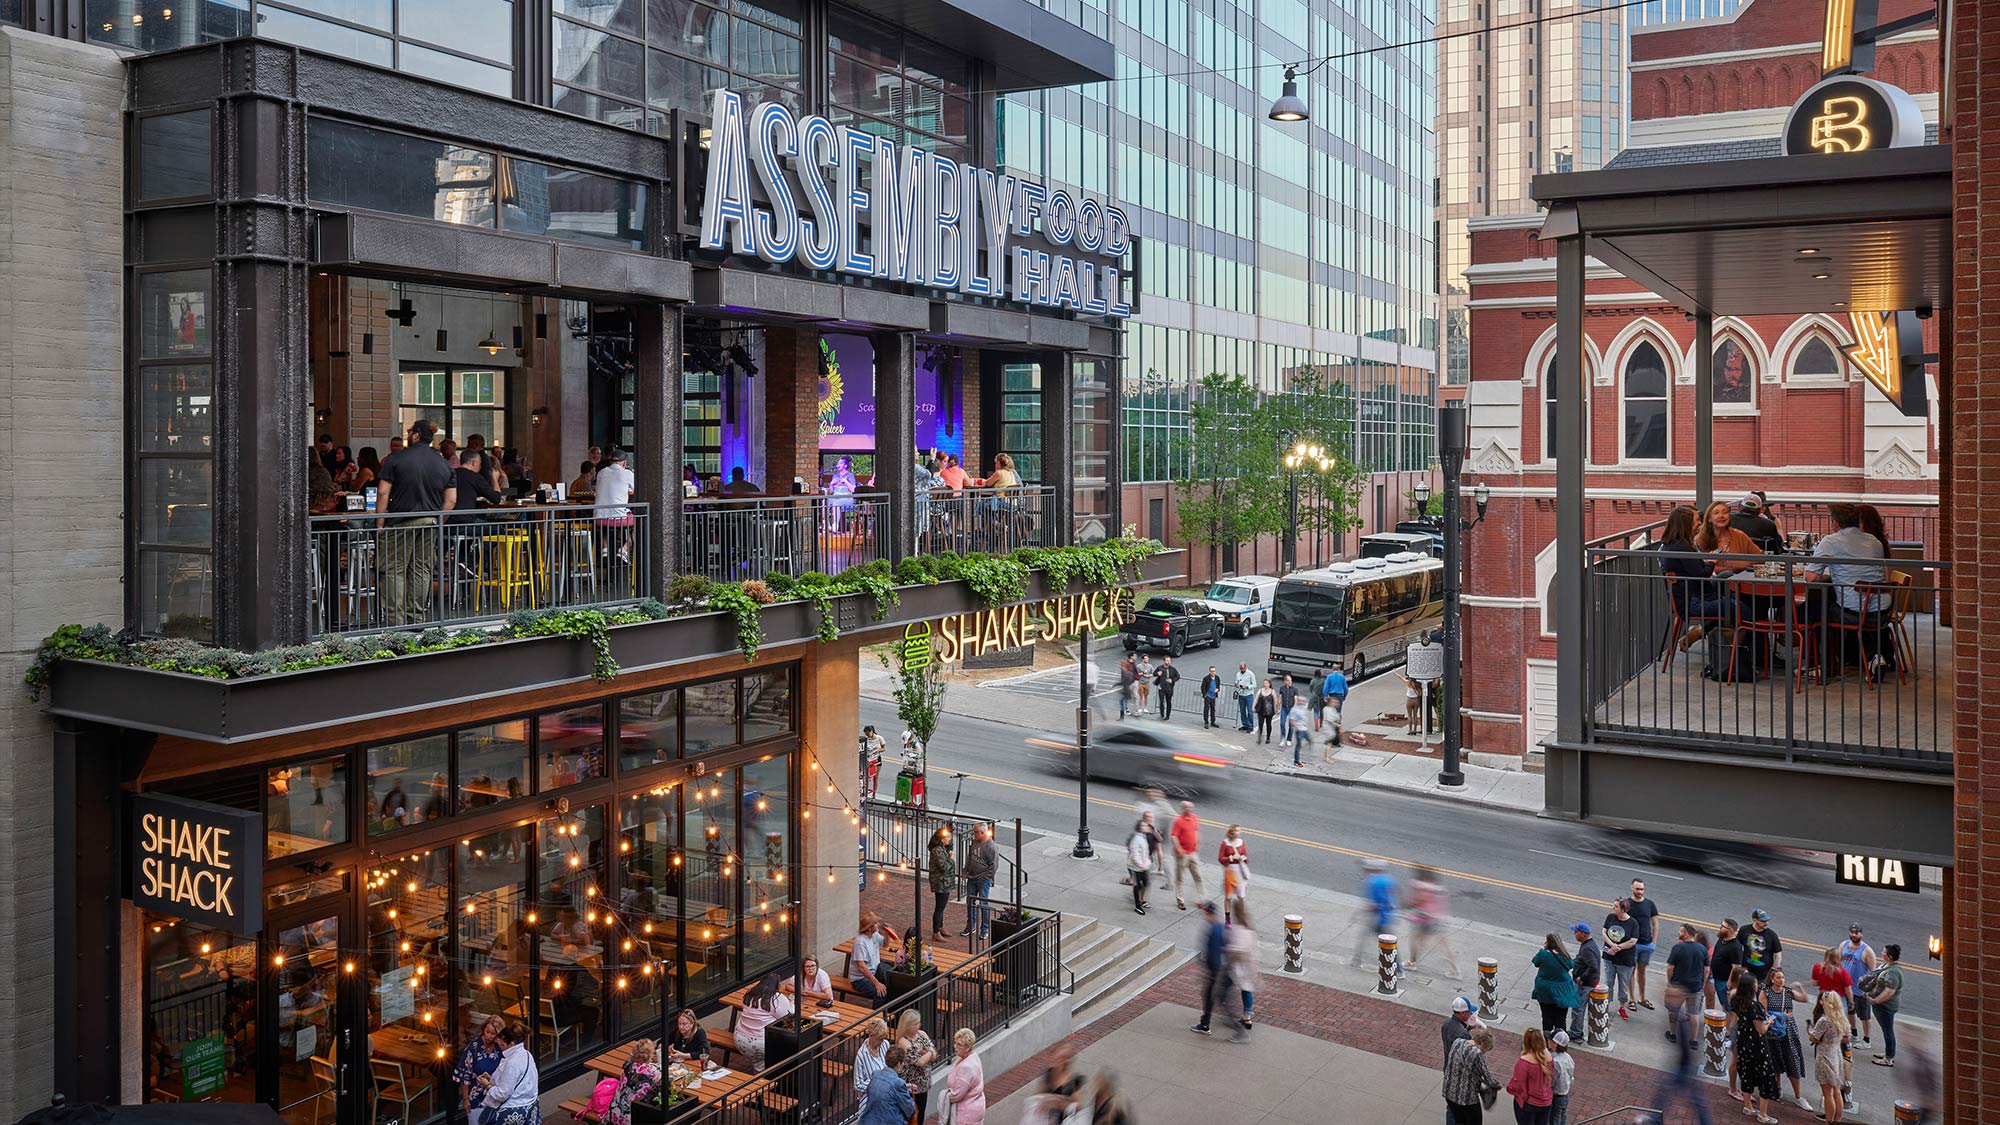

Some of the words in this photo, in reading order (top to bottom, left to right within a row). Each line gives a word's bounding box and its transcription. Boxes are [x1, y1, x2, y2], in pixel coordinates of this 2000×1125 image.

[700, 87, 1015, 298] ASSEMBLY
[1012, 181, 1131, 258] FOOD
[1012, 245, 1131, 319] HALL
[858, 402, 876, 413] Sca
[921, 402, 936, 415] tip
[936, 603, 1036, 665] SHAKE
[1040, 587, 1123, 642] SHACK
[141, 813, 231, 870] SHAKE
[141, 857, 234, 917] SHACK
[185, 1052, 201, 1063] OUR
[202, 1044, 223, 1057] TEAM!
[195, 1041, 213, 1052] JOIN
